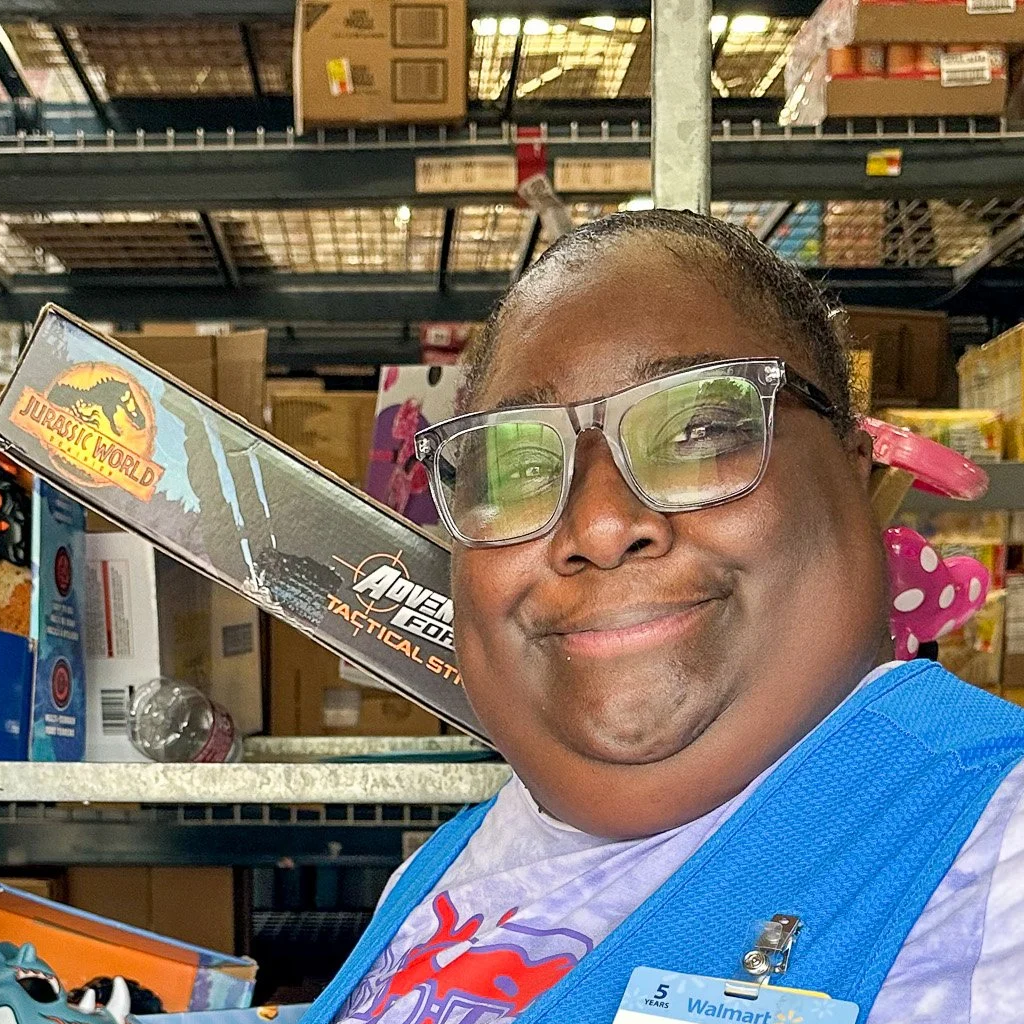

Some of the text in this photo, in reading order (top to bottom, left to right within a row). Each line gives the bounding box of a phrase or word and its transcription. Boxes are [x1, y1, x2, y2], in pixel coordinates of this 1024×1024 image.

[19, 395, 155, 487] JURASSIC WORLD
[326, 593, 423, 664] TACTICAL
[644, 998, 670, 1009] YEARS
[653, 983, 670, 1000] 5
